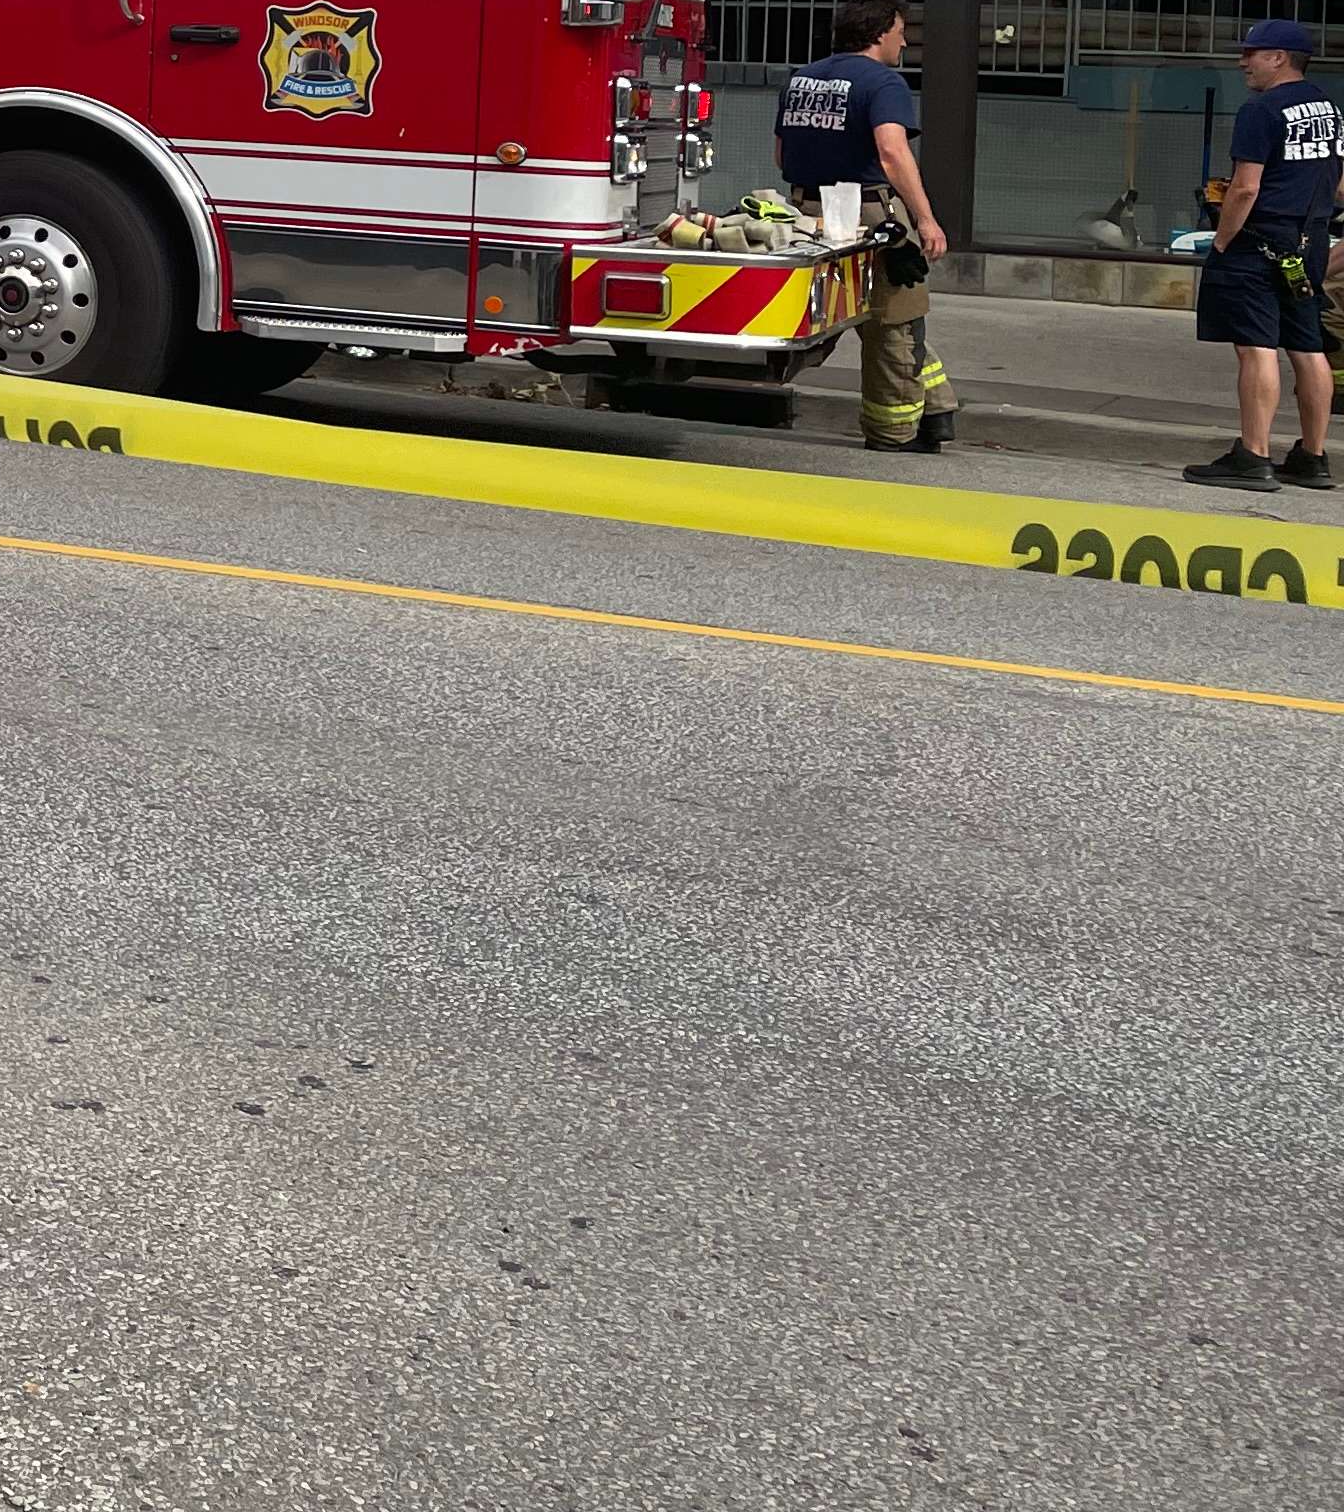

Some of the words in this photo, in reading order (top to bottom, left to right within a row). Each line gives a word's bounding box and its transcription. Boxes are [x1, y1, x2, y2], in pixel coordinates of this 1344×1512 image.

[292, 15, 350, 30] WINDSOR
[284, 79, 305, 94] FIRE
[315, 82, 352, 95] RESCUE
[785, 87, 848, 117] FIRE
[782, 110, 846, 131] RESCUE
